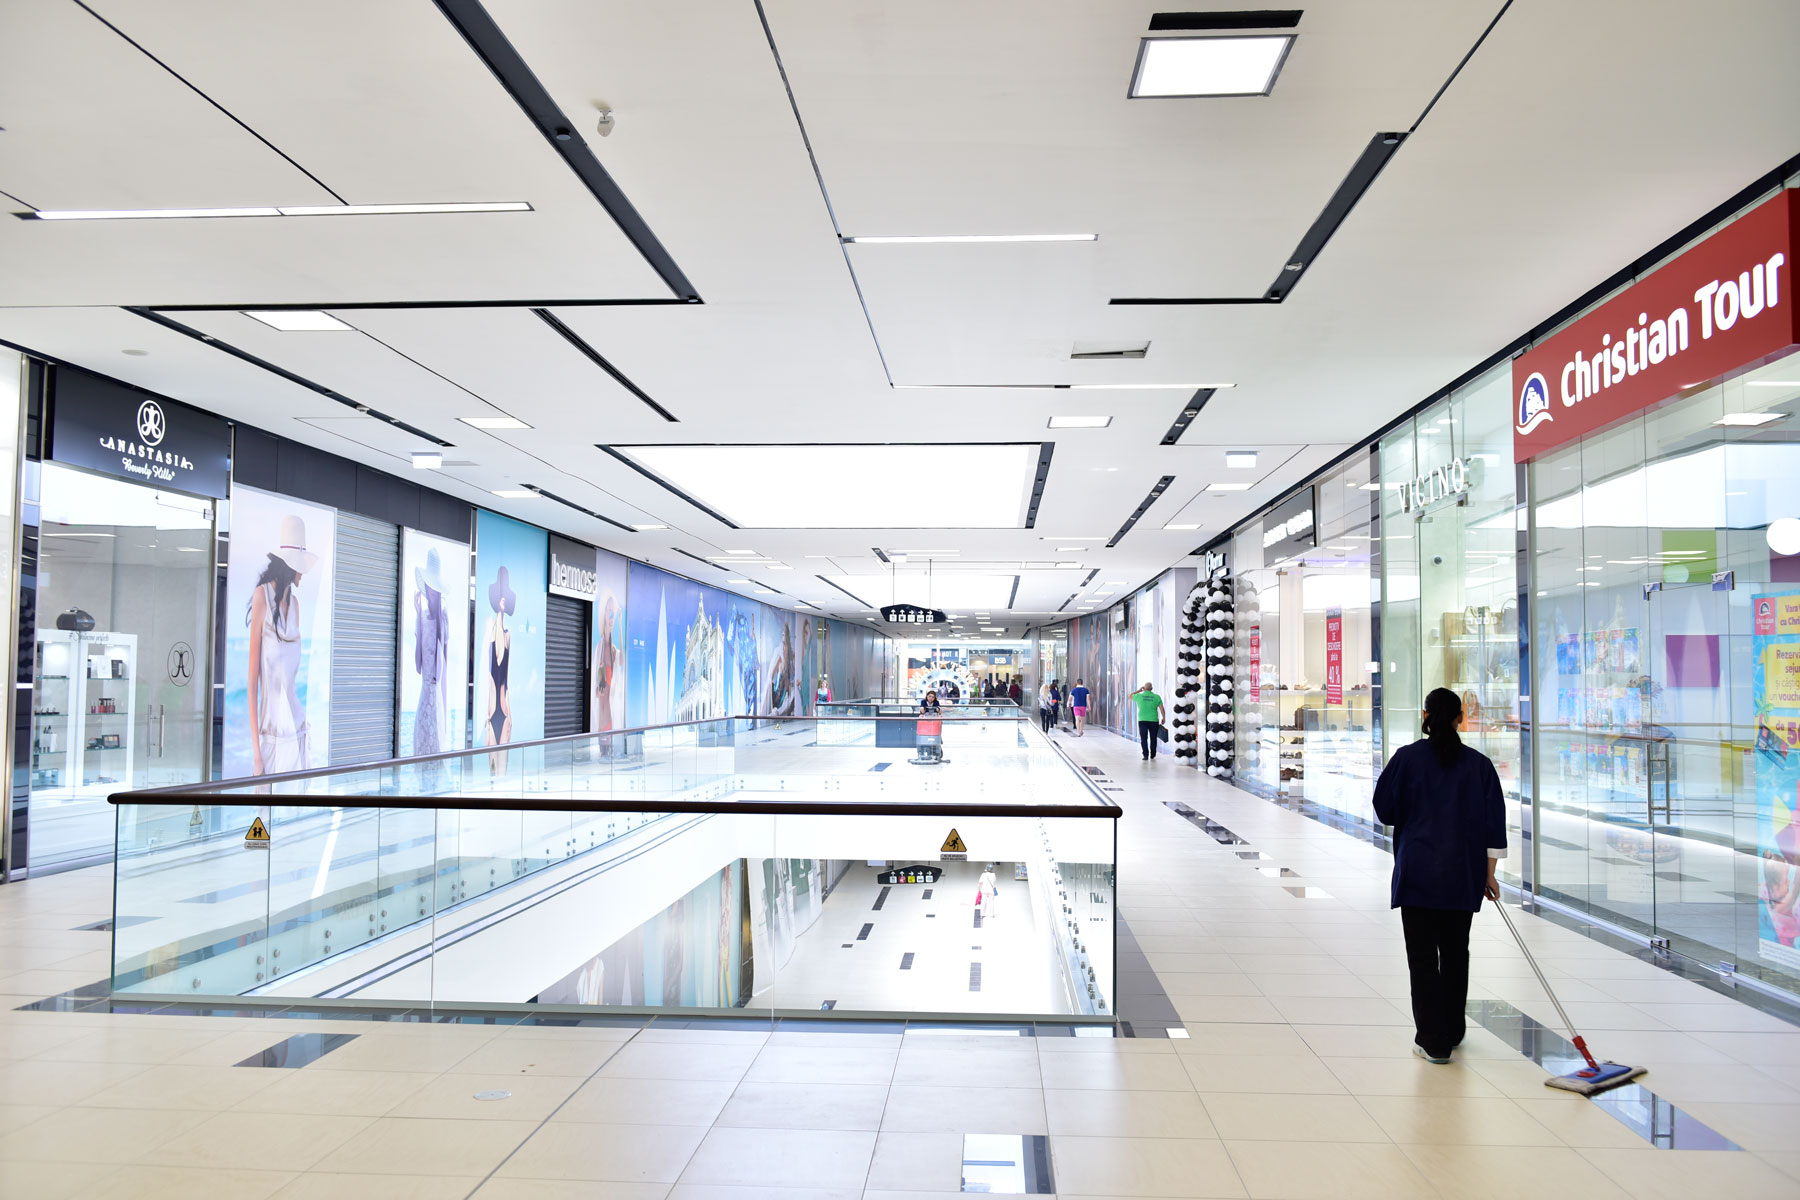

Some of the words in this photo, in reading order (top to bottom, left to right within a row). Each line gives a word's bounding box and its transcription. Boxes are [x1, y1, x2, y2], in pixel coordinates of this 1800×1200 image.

[1561, 312, 1689, 407] Christian
[1694, 252, 1785, 340] Tour
[99, 436, 194, 471] ANASTASIA
[122, 457, 152, 480] Beverly
[1398, 457, 1465, 514] VICINO
[551, 553, 598, 594] hermosa
